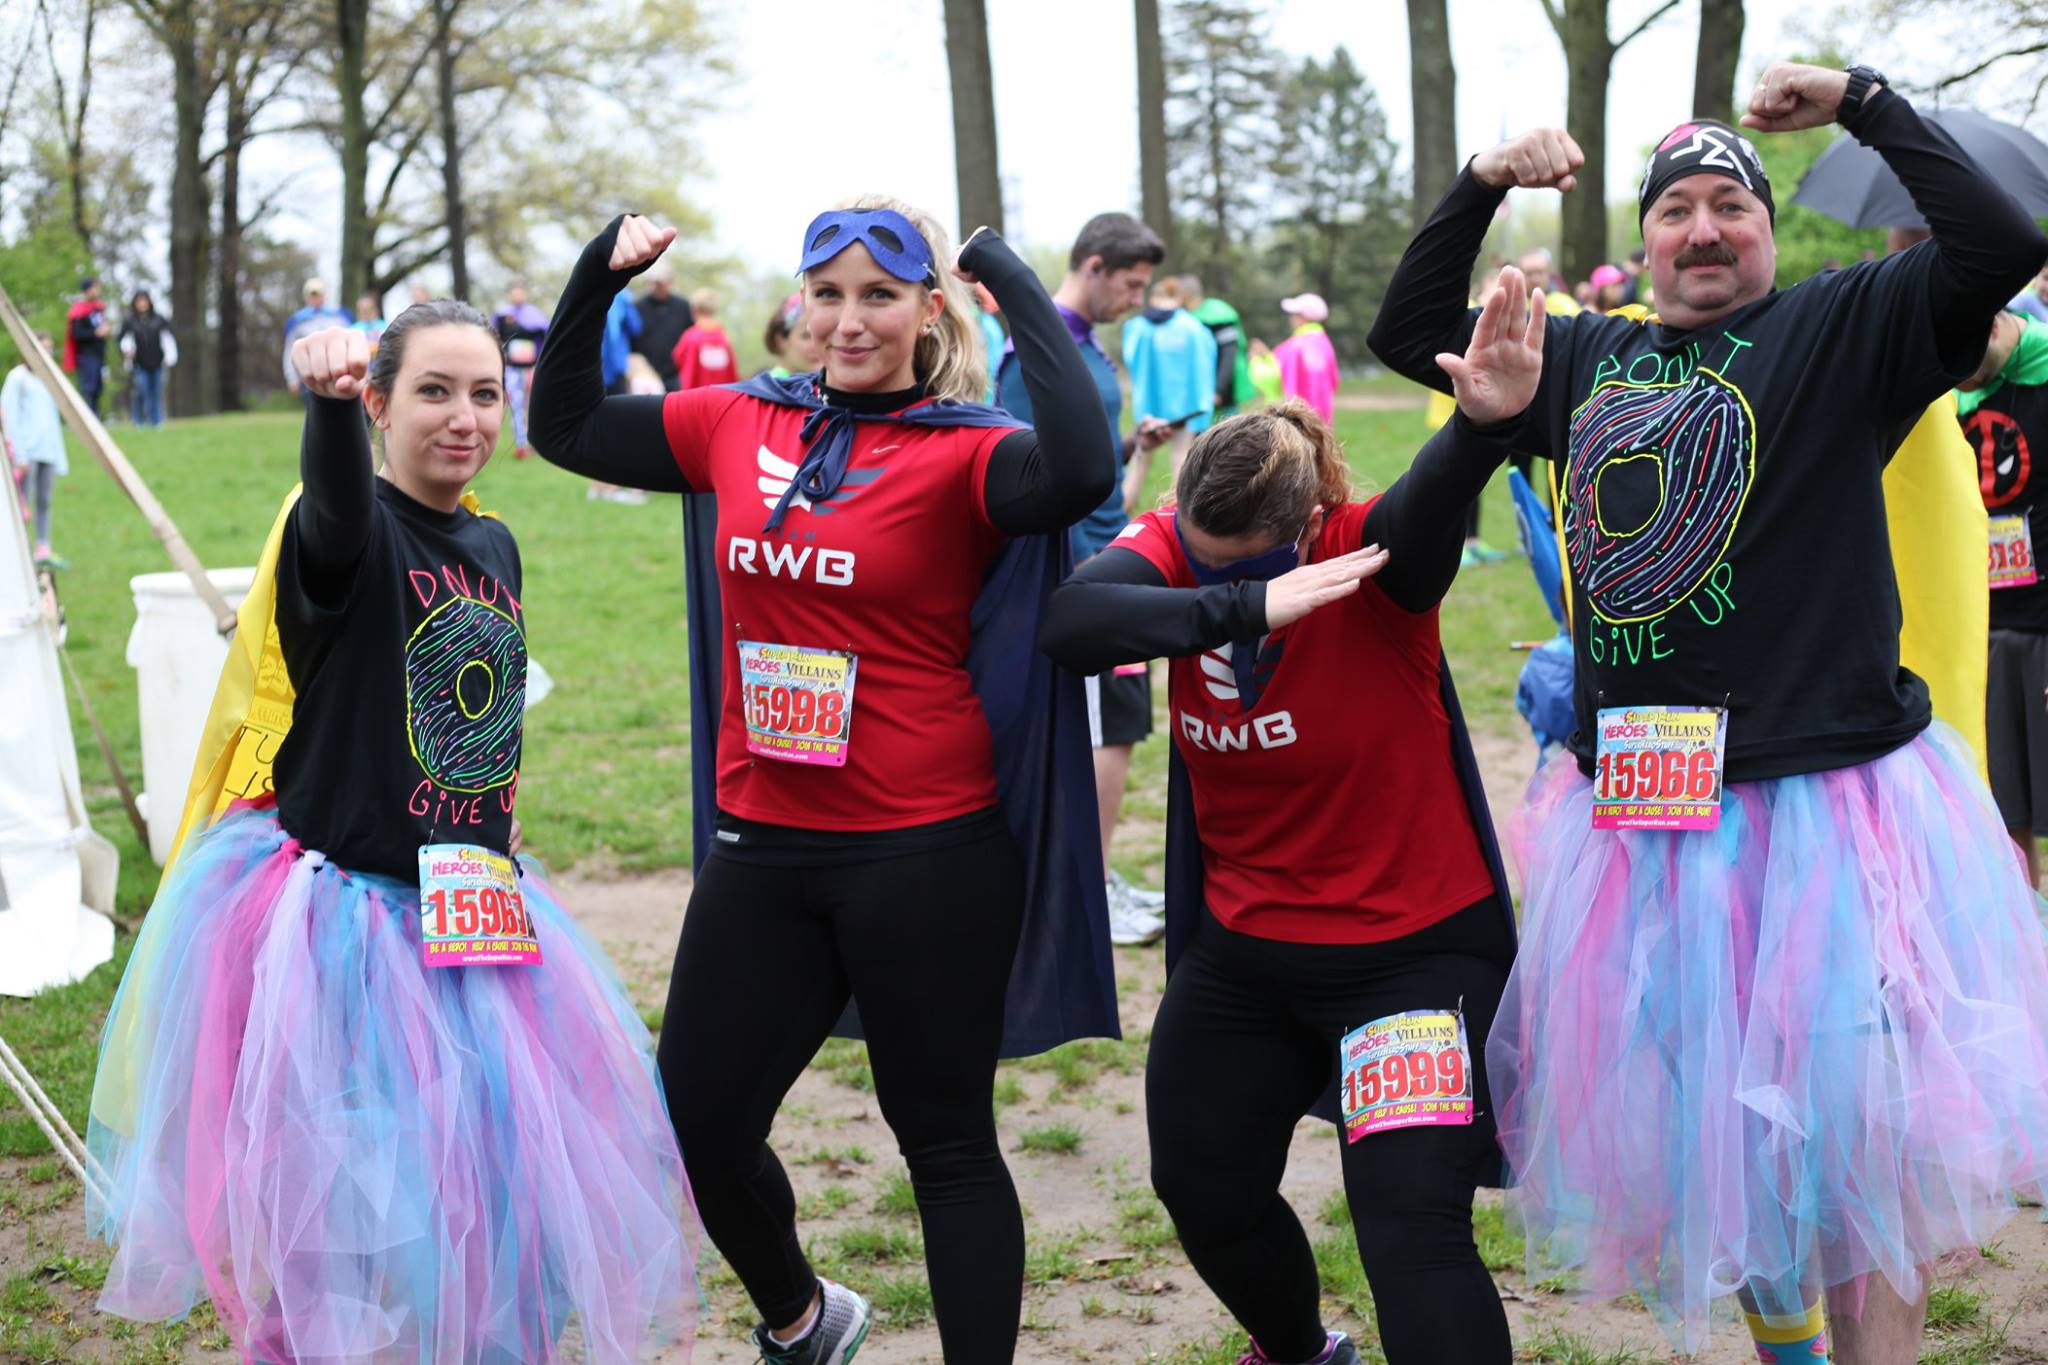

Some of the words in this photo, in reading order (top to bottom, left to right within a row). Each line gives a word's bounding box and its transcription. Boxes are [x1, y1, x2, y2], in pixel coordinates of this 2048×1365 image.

[728, 536, 856, 586] RWB
[1689, 562, 1736, 626] UP
[745, 657, 781, 674] HEROES
[786, 662, 841, 680] VILLAINS
[745, 683, 844, 738] 15998
[1180, 710, 1298, 752] RWB
[1603, 723, 1648, 740] HEROES
[1654, 724, 1712, 738] VILLAINS
[1599, 750, 1715, 800] 15966
[431, 861, 483, 876] HEROES
[1349, 1033, 1390, 1060] HEROES
[1395, 1026, 1454, 1042] VILLAINS
[1345, 1049, 1465, 1113] 15999
